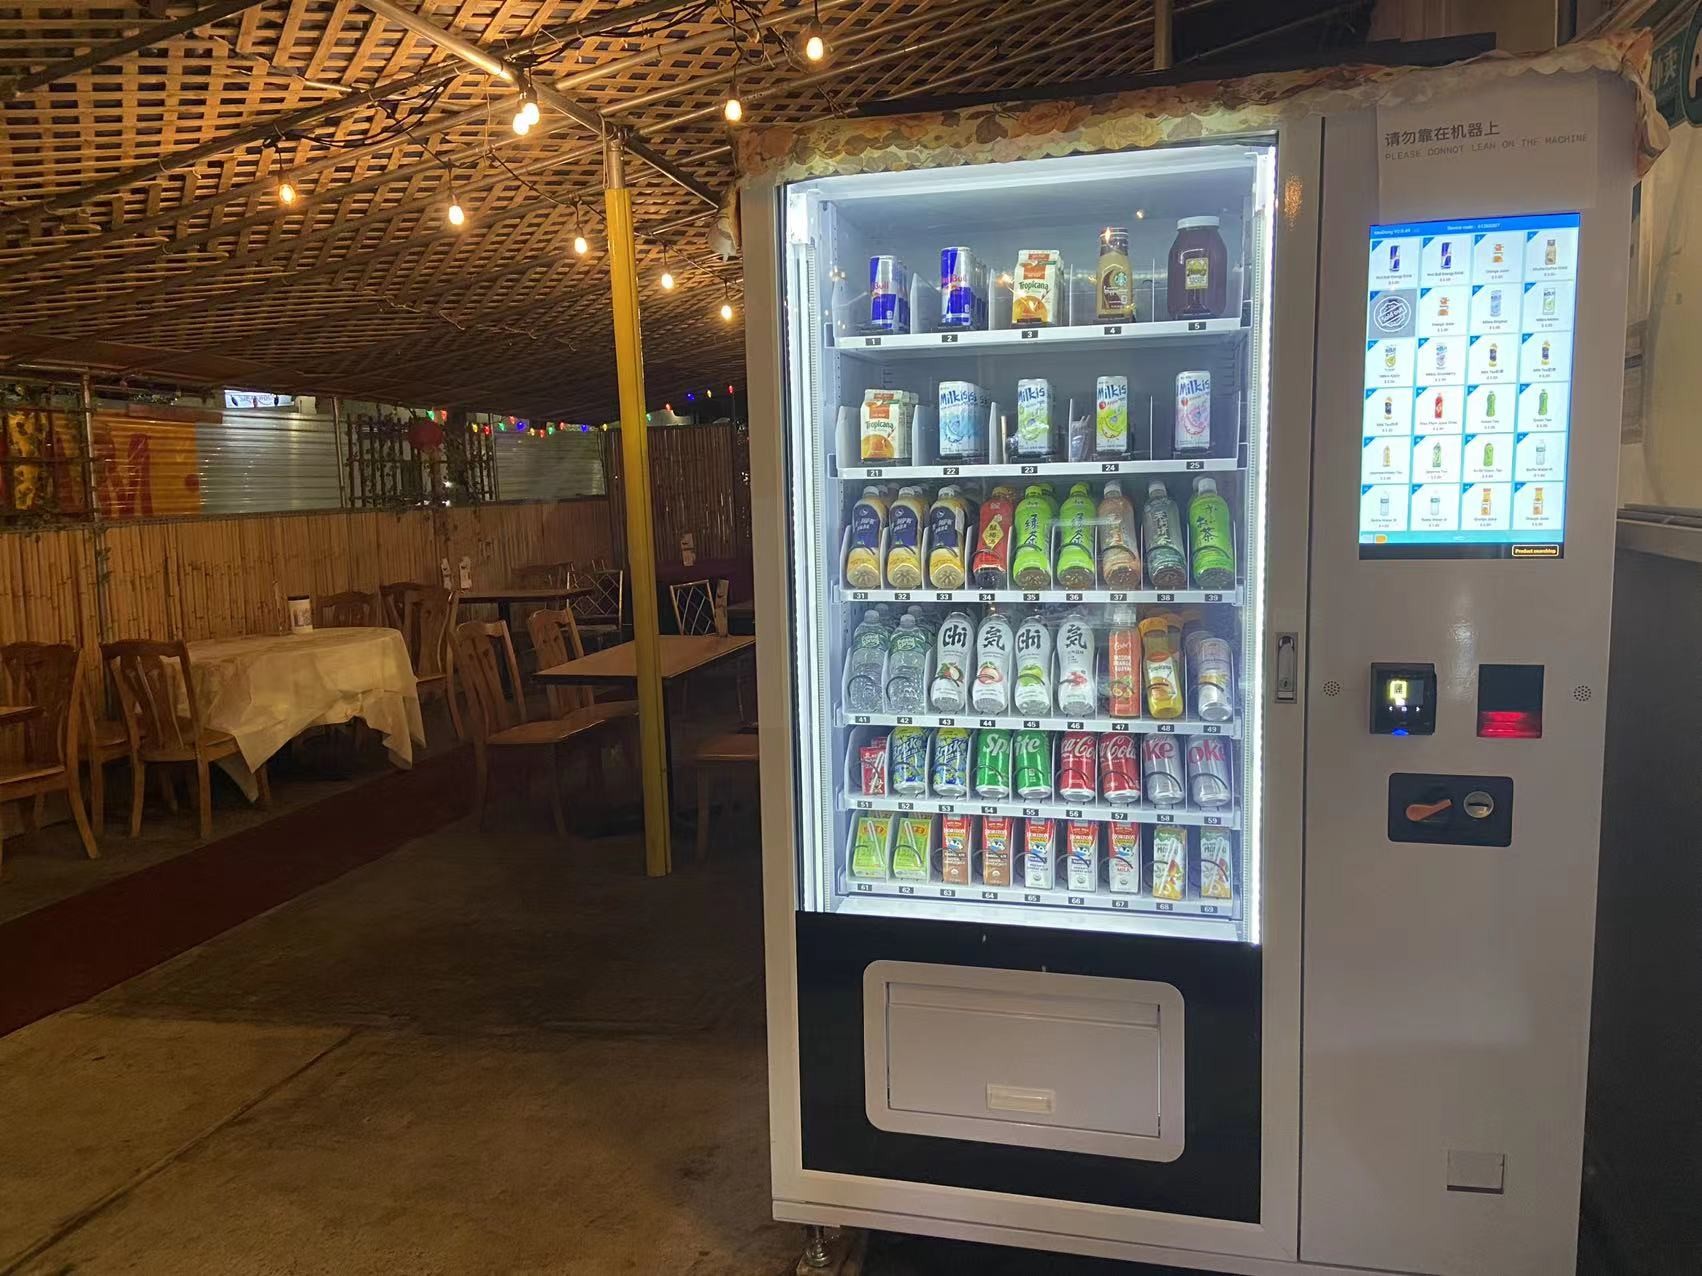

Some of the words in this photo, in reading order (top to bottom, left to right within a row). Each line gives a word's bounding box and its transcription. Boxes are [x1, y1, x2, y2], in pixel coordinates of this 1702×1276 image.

[1385, 121, 1500, 147] 请勿靠在机器上
[1385, 151, 1422, 161] PLEASE
[1471, 144, 1496, 152] LEAN
[1502, 140, 1516, 149] ON
[1522, 138, 1538, 147] THE
[1545, 134, 1589, 144] MACHINE
[1019, 280, 1049, 290] Tropicana
[1098, 384, 1127, 400] Milkis
[1180, 379, 1210, 397] Milkis
[940, 390, 968, 405] Milkis
[1018, 386, 1045, 403] Milkis
[865, 420, 894, 429] Tropicana
[1105, 464, 1116, 472] 24
[1189, 461, 1201, 469] 25
[870, 469, 879, 477] 21
[1024, 466, 1035, 474] 23
[856, 592, 865, 600] 31
[982, 593, 992, 601] 34
[1069, 593, 1080, 601] 36
[1113, 593, 1124, 601] 37
[941, 718, 952, 726] 43
[1115, 723, 1125, 731] 47
[984, 806, 994, 814] 54
[1025, 808, 1036, 816] 55
[1069, 810, 1079, 818] 56
[1160, 814, 1170, 822] 58
[1115, 900, 1125, 908] 67
